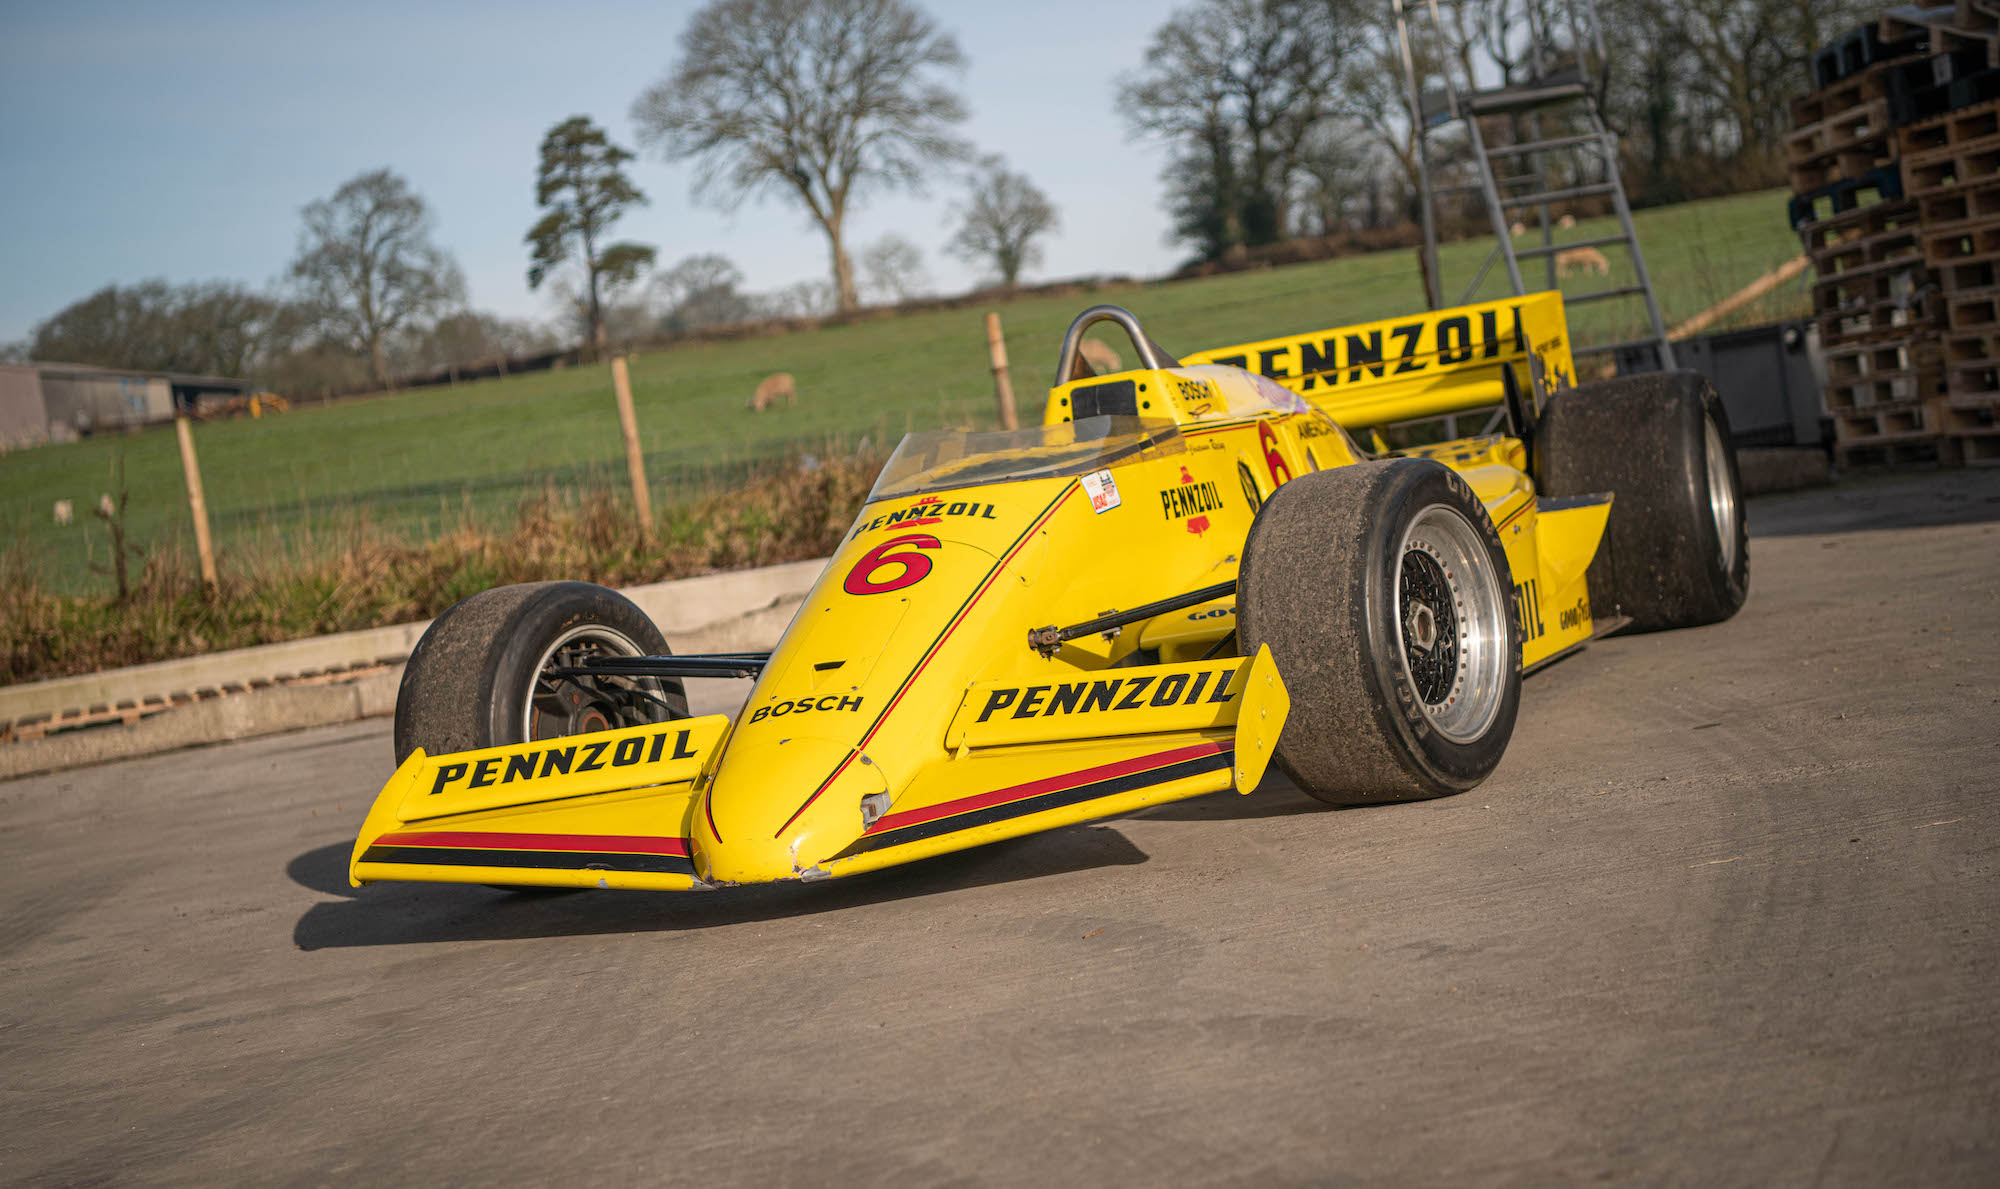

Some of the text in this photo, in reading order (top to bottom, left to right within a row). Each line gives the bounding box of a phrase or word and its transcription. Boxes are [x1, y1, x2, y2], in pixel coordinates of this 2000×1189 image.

[1177, 380, 1213, 400] BOSCH
[1160, 481, 1223, 520] PENNZOIL
[850, 502, 996, 541] PENNZOIL
[843, 534, 942, 596] 6
[749, 696, 864, 724] BOSCH
[974, 669, 1237, 723] PENNZOIL
[428, 729, 698, 795] PENNZOIL
